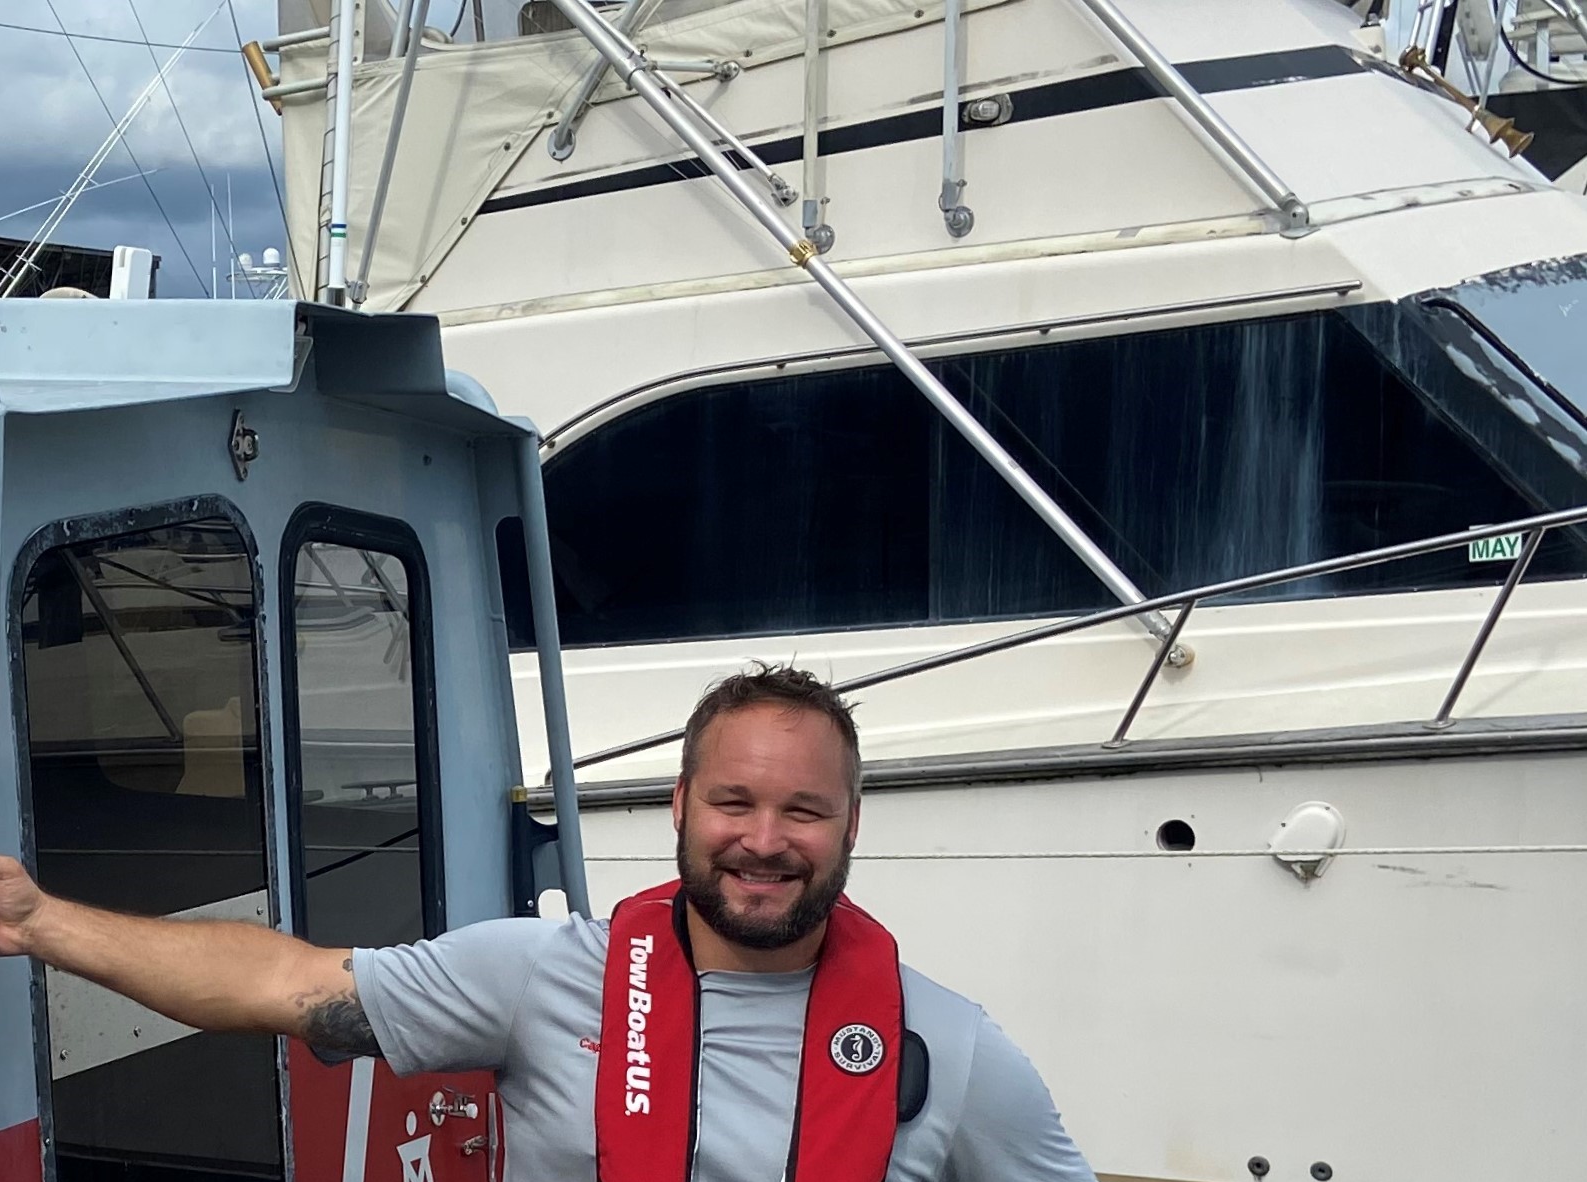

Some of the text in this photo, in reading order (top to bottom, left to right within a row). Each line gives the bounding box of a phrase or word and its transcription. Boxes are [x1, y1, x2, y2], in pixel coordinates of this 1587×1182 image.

[1471, 536, 1519, 559] MAY
[625, 935, 654, 1117] TowBoatU.S.
[834, 1026, 880, 1046] MUSTANG
[834, 1050, 881, 1070] SURVIVAL
